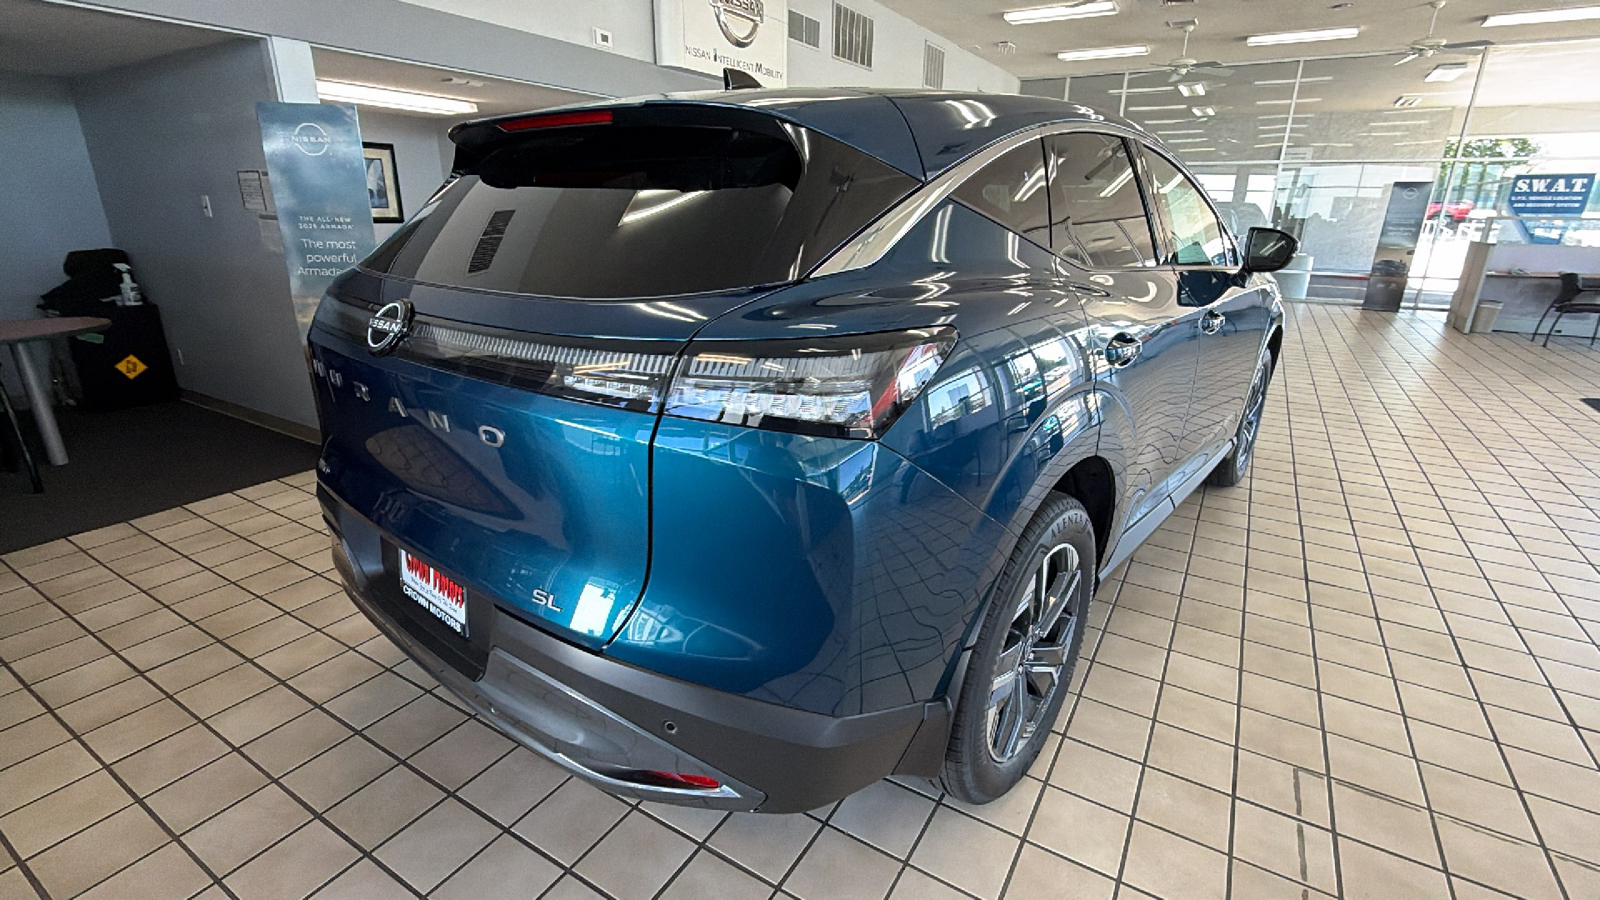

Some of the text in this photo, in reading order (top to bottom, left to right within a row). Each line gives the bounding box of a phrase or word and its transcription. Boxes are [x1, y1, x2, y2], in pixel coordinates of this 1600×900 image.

[720, 0, 763, 17] ISSAN
[685, 45, 783, 79] NISSAN INTELLIGENT MOBILITY
[291, 135, 331, 143] NISSAN
[299, 215, 314, 223] THE
[298, 222, 317, 230] 2025
[300, 238, 356, 249] The most
[306, 252, 357, 264] powerful
[532, 588, 563, 612] SL
[402, 584, 429, 609] CROWN
[429, 602, 462, 633] MOTORS
